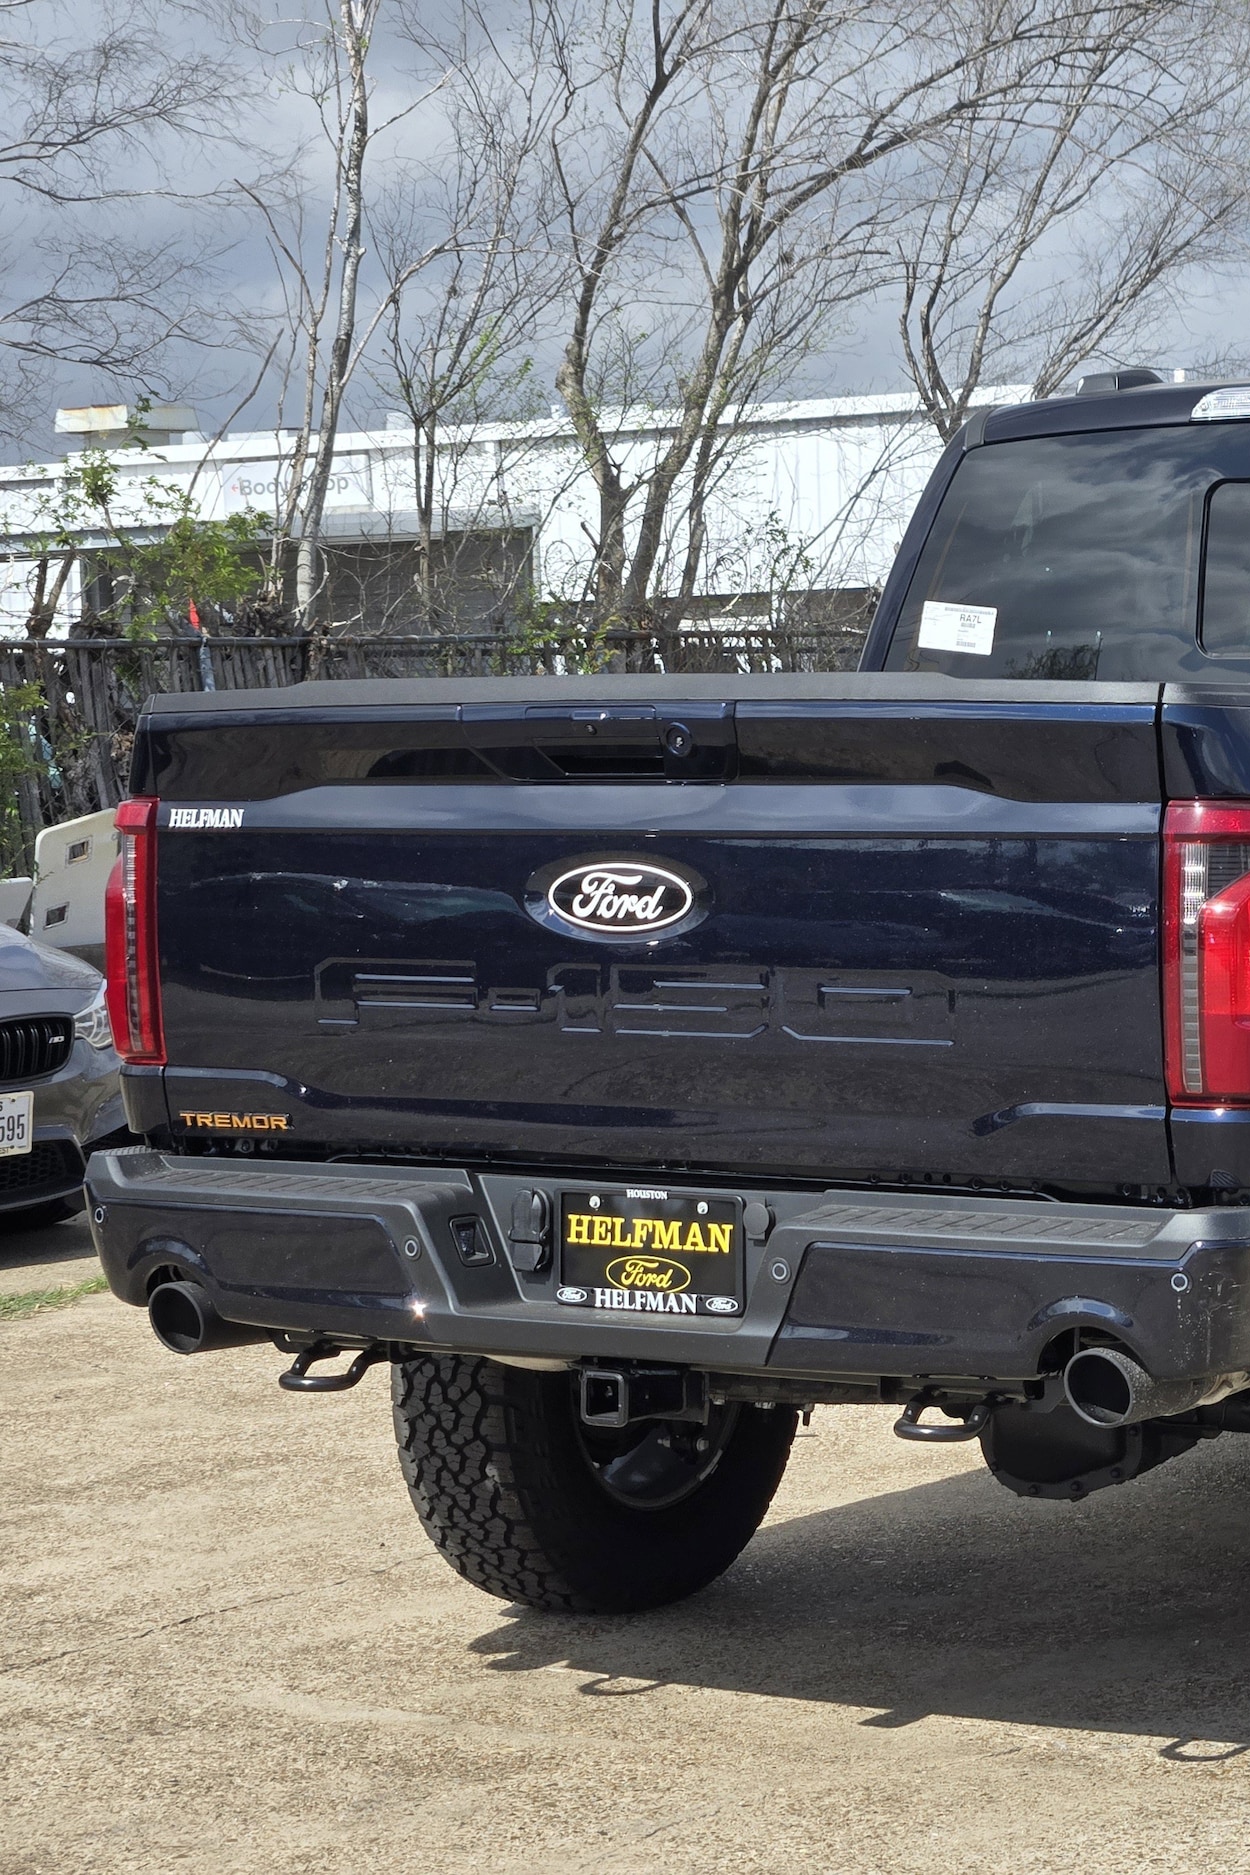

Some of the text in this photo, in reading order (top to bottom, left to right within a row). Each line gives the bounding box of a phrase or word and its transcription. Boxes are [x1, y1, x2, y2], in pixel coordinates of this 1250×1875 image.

[960, 613, 982, 624] RA7L
[168, 808, 245, 829] HELFMAN
[572, 871, 666, 920] Ford
[179, 1111, 291, 1130] TREMOR
[626, 1188, 668, 1200] HOUSTON
[566, 1213, 734, 1253] HELFMAN
[620, 1258, 674, 1290] Ford
[594, 1287, 699, 1314] HELFMAN
